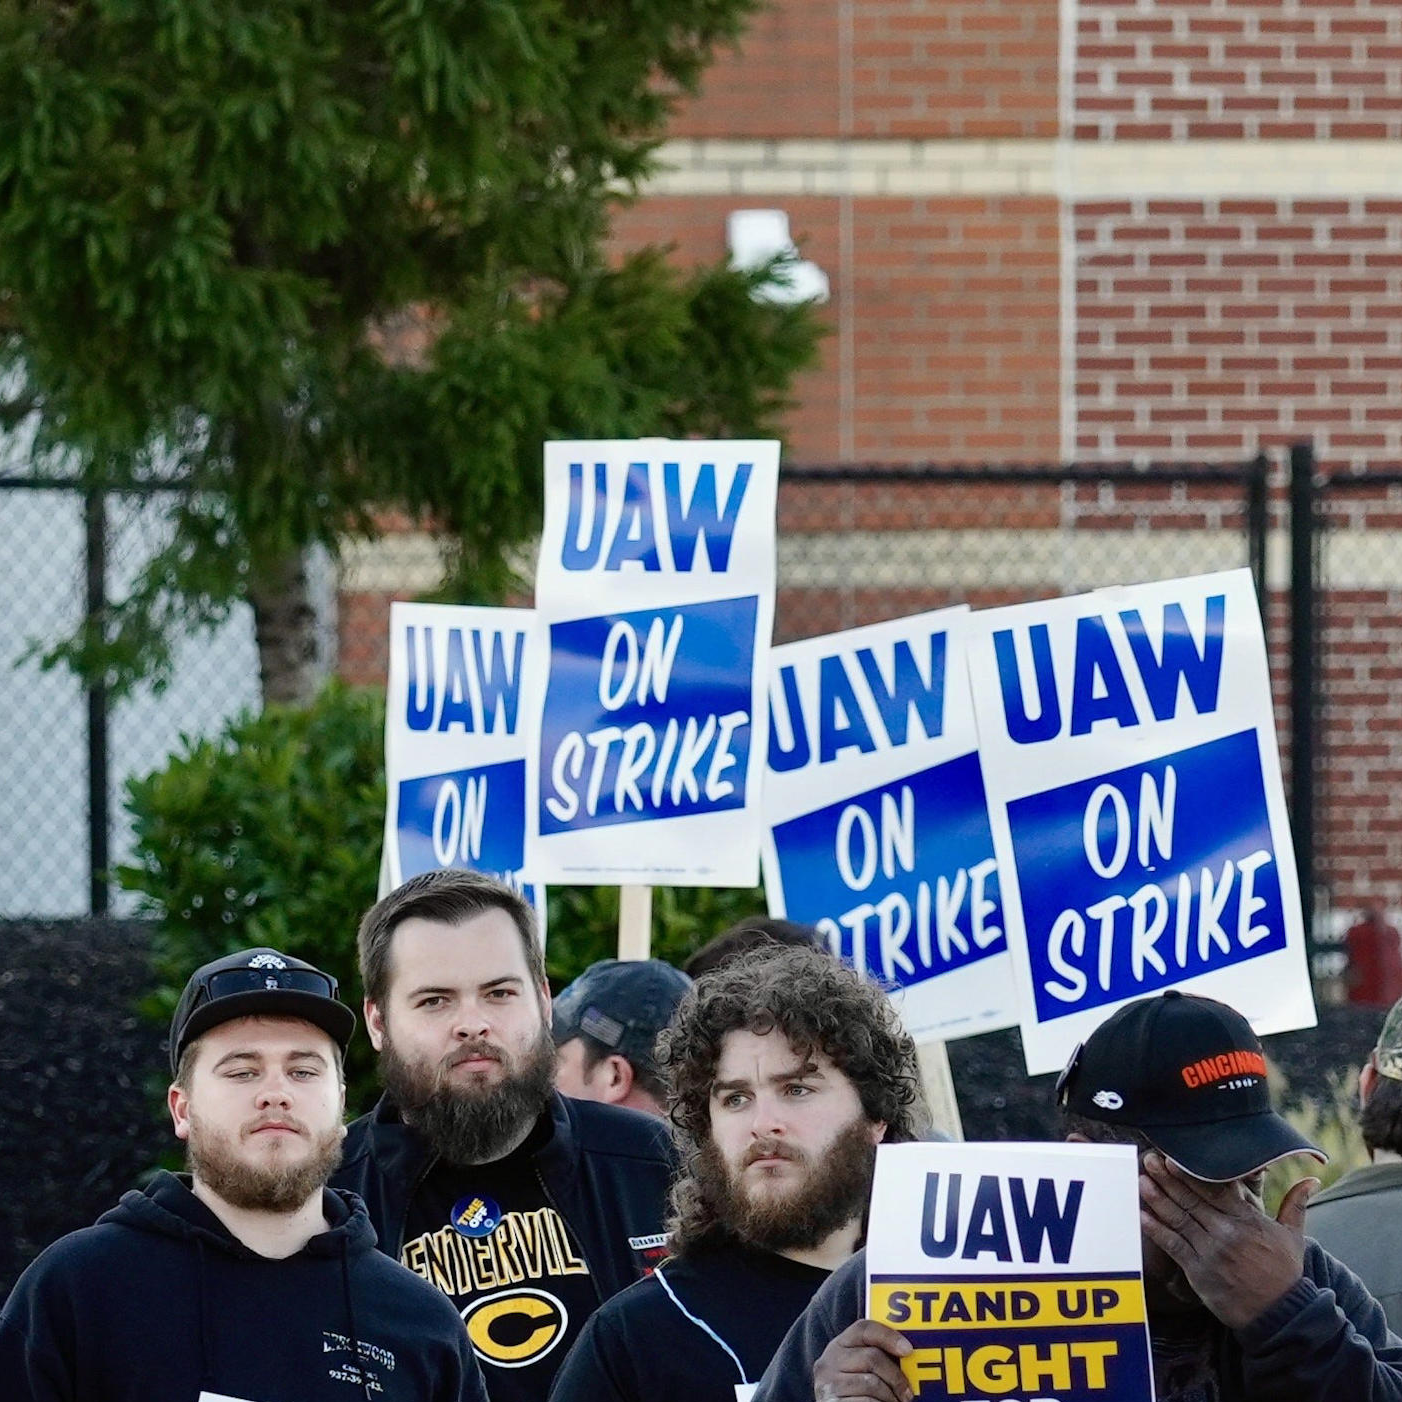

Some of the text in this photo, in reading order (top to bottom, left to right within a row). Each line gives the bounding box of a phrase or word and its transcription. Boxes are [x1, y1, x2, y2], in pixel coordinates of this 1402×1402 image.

[561, 463, 753, 573] UAW
[405, 627, 525, 735] UAW
[599, 616, 683, 711] ON
[767, 631, 947, 773] UAW
[997, 595, 1227, 744] UAW
[546, 711, 749, 822] STRIKE
[431, 775, 487, 866] ON
[835, 785, 915, 891] ON
[1081, 765, 1177, 879] ON
[1043, 850, 1272, 1002] STRIKE
[401, 1207, 590, 1295] ENTERVIL
[456, 1198, 484, 1226] TIME
[469, 1206, 487, 1229] OFF
[919, 1172, 1086, 1264] UAW
[886, 1288, 1120, 1323] STAND UP
[901, 1341, 1118, 1396] FIGHT
